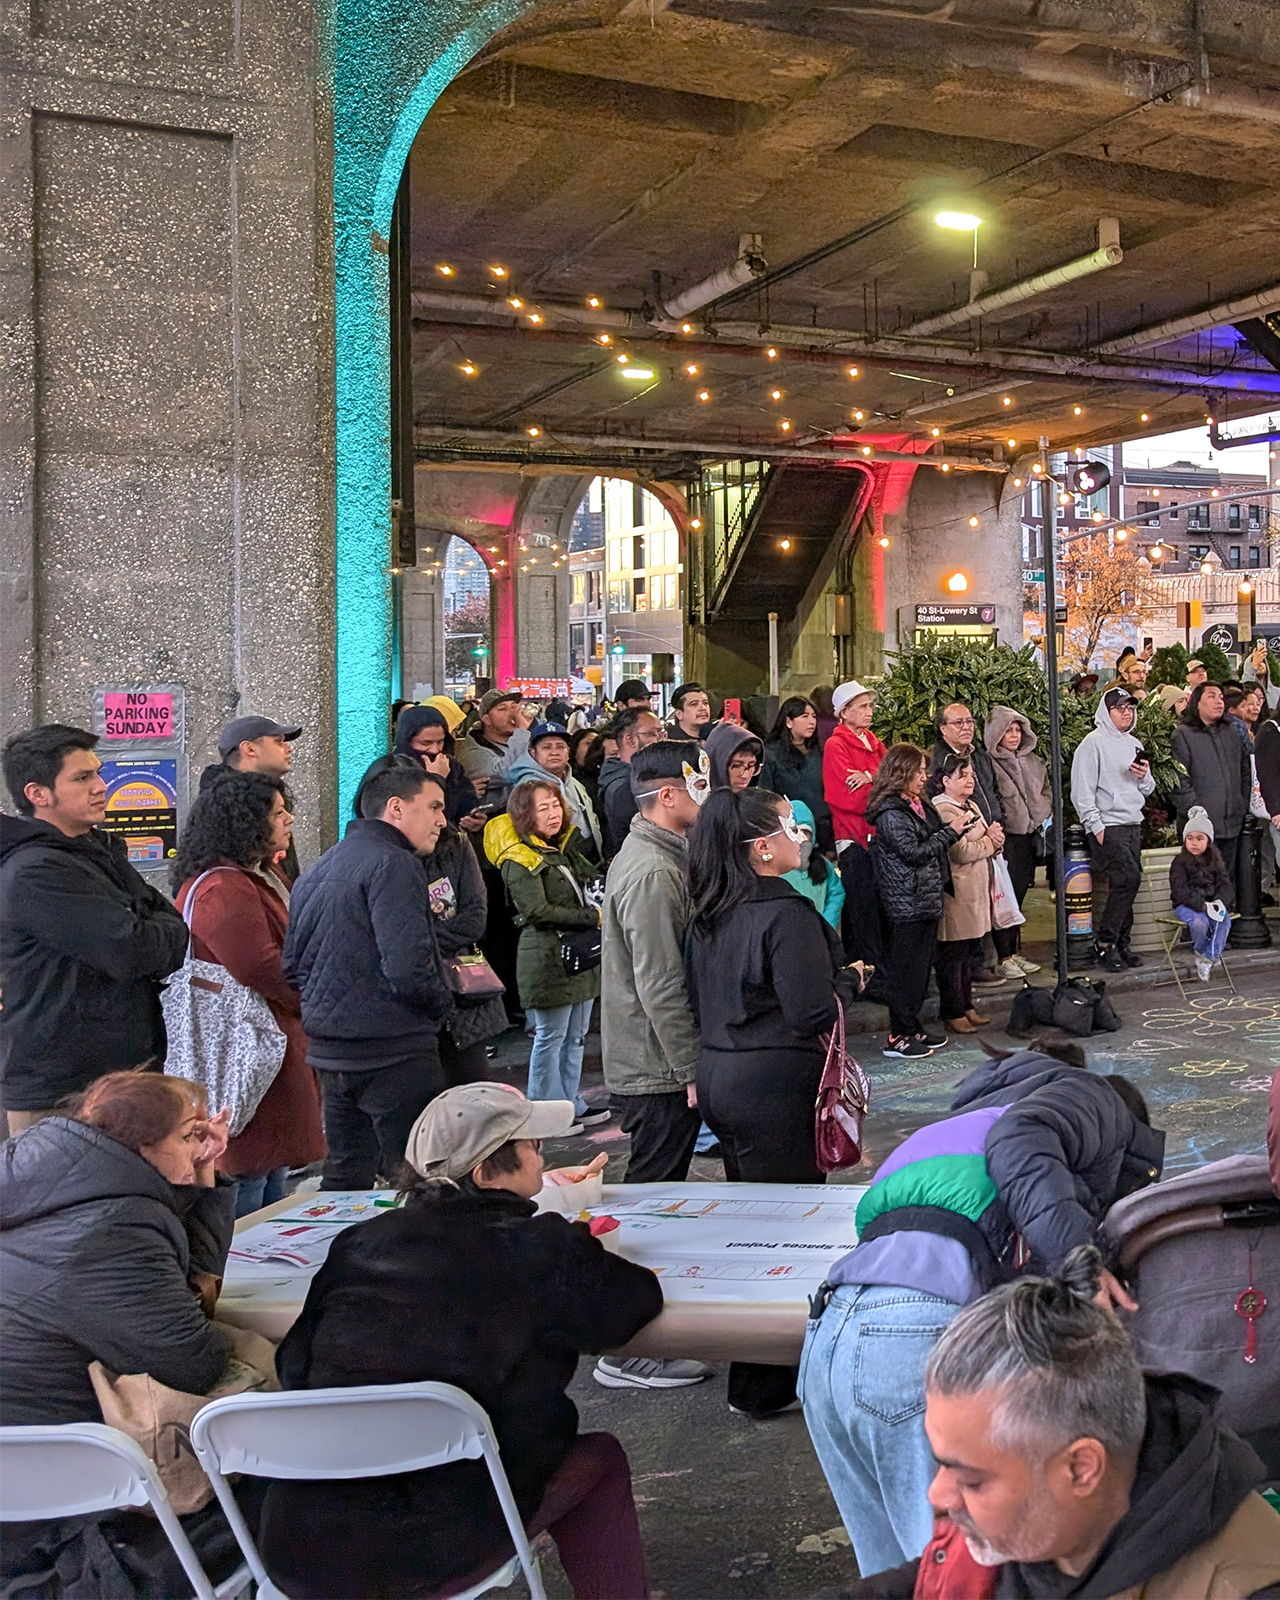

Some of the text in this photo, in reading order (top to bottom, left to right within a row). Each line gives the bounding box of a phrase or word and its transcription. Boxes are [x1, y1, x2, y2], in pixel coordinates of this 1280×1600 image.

[1022, 572, 1033, 581] 40
[917, 606, 978, 616] 40 St-Lowery St
[984, 610, 991, 619] 7
[126, 693, 148, 705] NO
[105, 707, 170, 720] PARKING
[106, 722, 167, 735] SUNDAY
